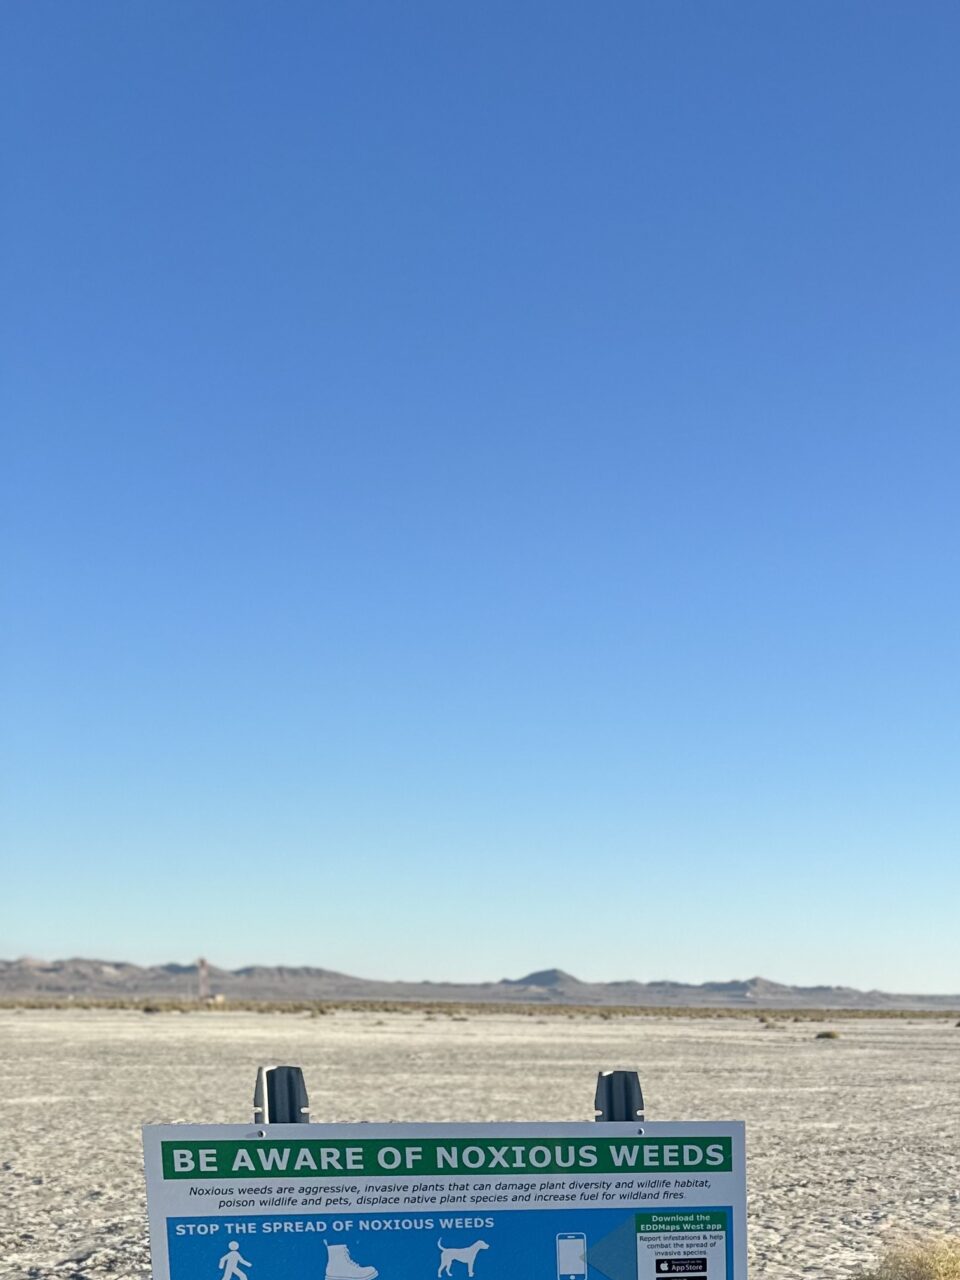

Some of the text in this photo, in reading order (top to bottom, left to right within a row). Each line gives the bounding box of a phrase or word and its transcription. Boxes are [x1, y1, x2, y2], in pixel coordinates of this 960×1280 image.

[173, 1144, 724, 1172] BE AWARE OF NOXIOUS WEEDS
[189, 1179, 711, 1196] Noxious weeds are aggressive, invasive plants that can damage plant diversity and wildlife habitat,
[218, 1198, 255, 1208] poison
[259, 1197, 298, 1207] wildlife
[301, 1197, 322, 1206] and
[325, 1196, 352, 1207] pets,
[356, 1195, 400, 1205] displace
[403, 1195, 436, 1204] native
[440, 1194, 466, 1204] plant
[470, 1193, 508, 1203] species
[512, 1193, 531, 1201] and
[534, 1192, 576, 1201] increase
[580, 1192, 599, 1200] fuel
[602, 1191, 617, 1200] for
[619, 1191, 660, 1199] wildland
[176, 1218, 494, 1236] STOP THE SPREAD OF NOXIOUS WEEDS
